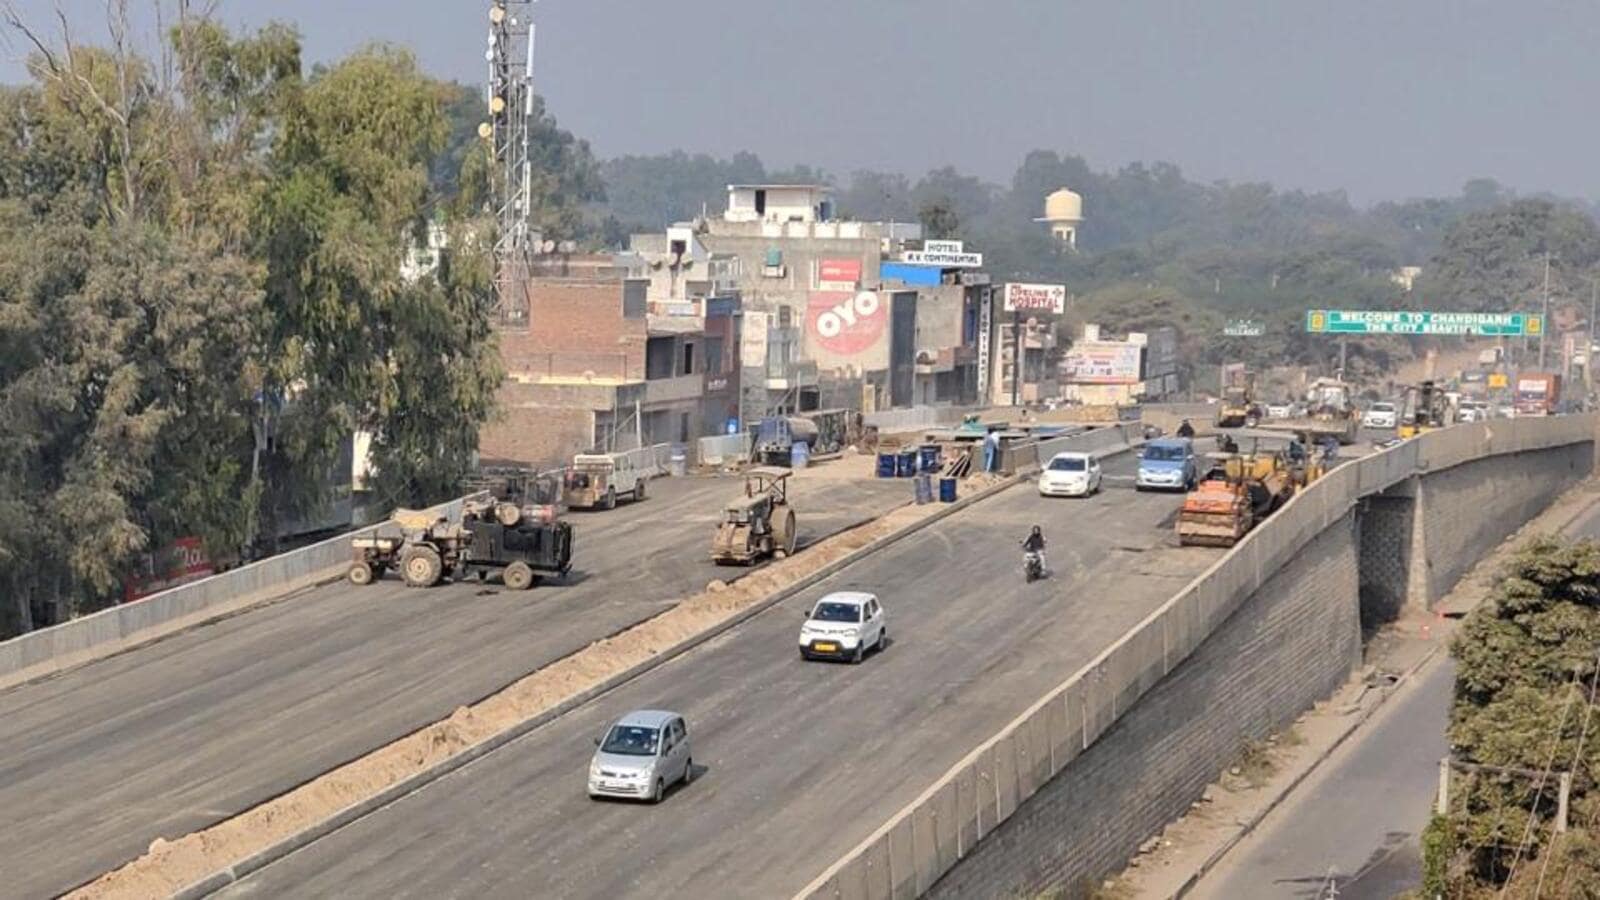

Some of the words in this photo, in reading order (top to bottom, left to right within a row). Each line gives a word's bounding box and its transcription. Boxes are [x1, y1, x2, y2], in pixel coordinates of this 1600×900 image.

[927, 242, 960, 253] HOTEL
[924, 254, 978, 265] CONTINENTAL
[1009, 297, 1059, 311] HOSPITAL
[816, 290, 879, 338] OYO
[1341, 311, 1399, 323] WELCOME
[1408, 311, 1424, 323] TO
[1430, 312, 1508, 325] CHANDIGARH
[1366, 322, 1387, 333] THE
[1392, 322, 1417, 333] CITY
